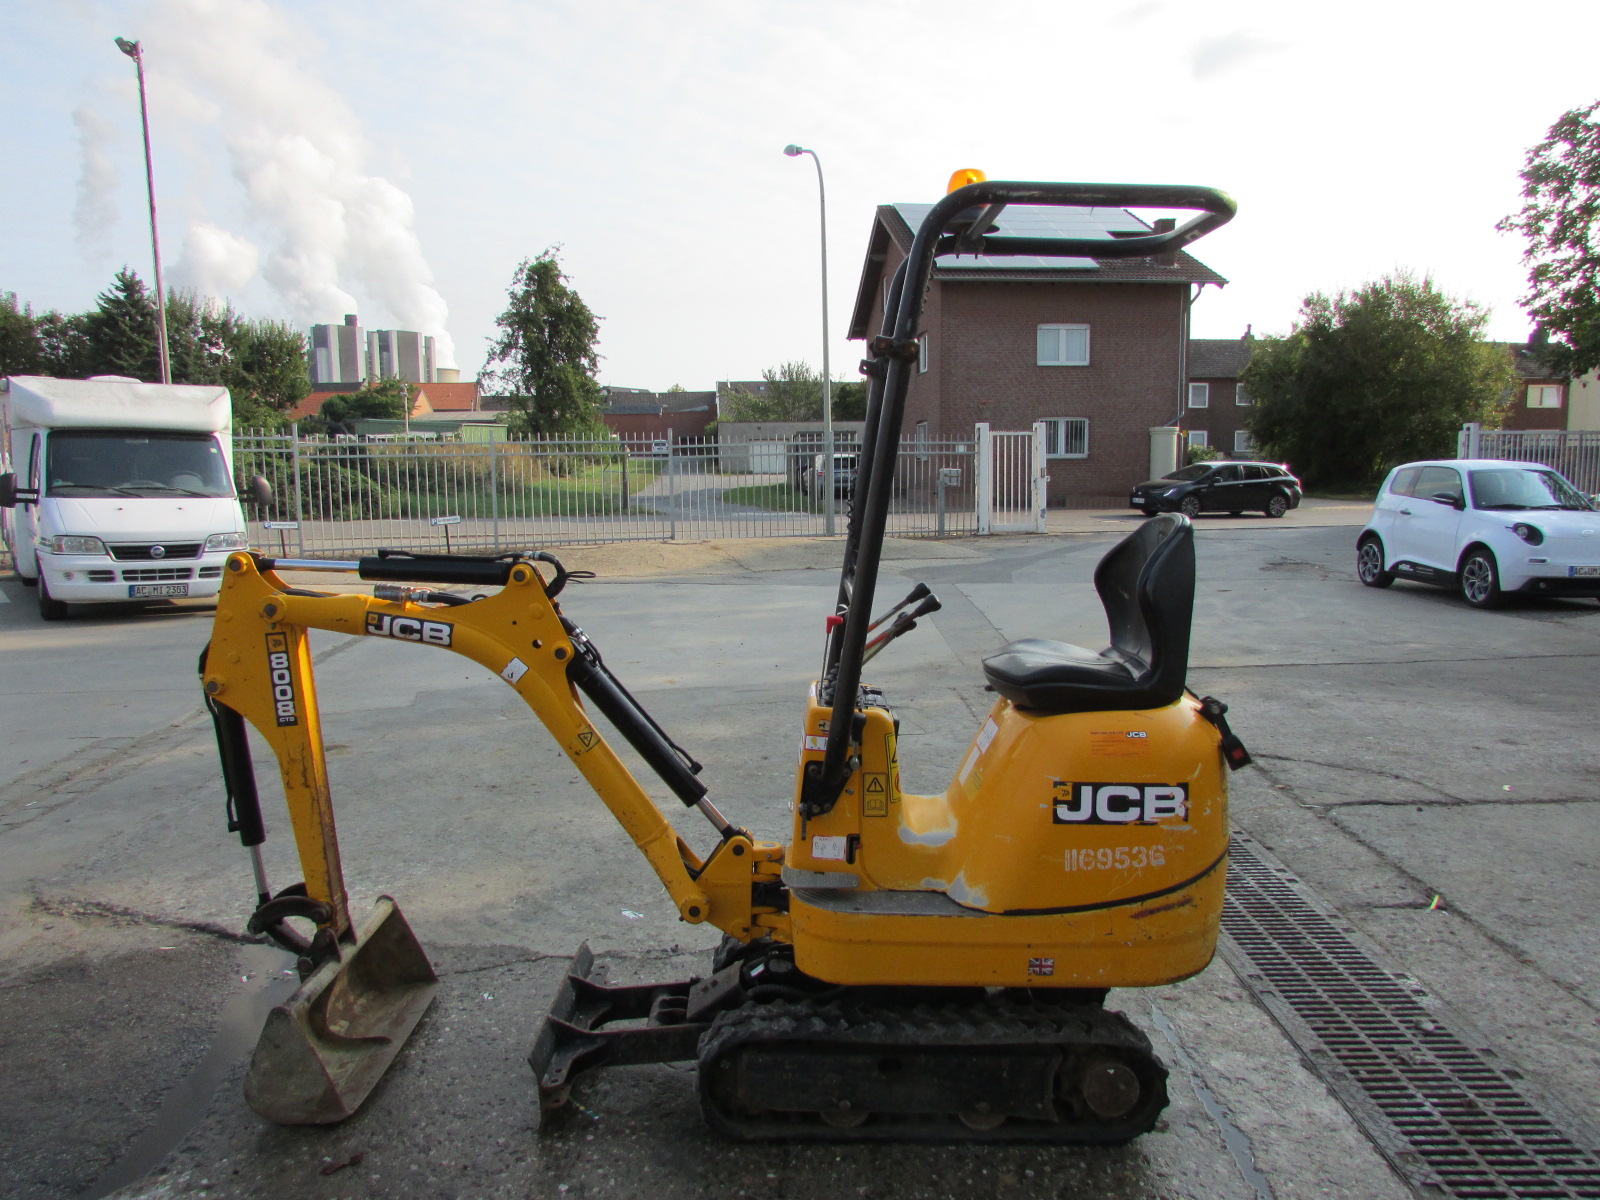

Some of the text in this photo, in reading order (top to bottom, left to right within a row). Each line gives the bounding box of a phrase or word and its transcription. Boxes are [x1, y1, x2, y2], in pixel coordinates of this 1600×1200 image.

[136, 586, 146, 595] AC
[153, 586, 163, 595] MI
[367, 613, 451, 646] JCB
[270, 652, 295, 717] 8008
[1056, 785, 1186, 822] JCB
